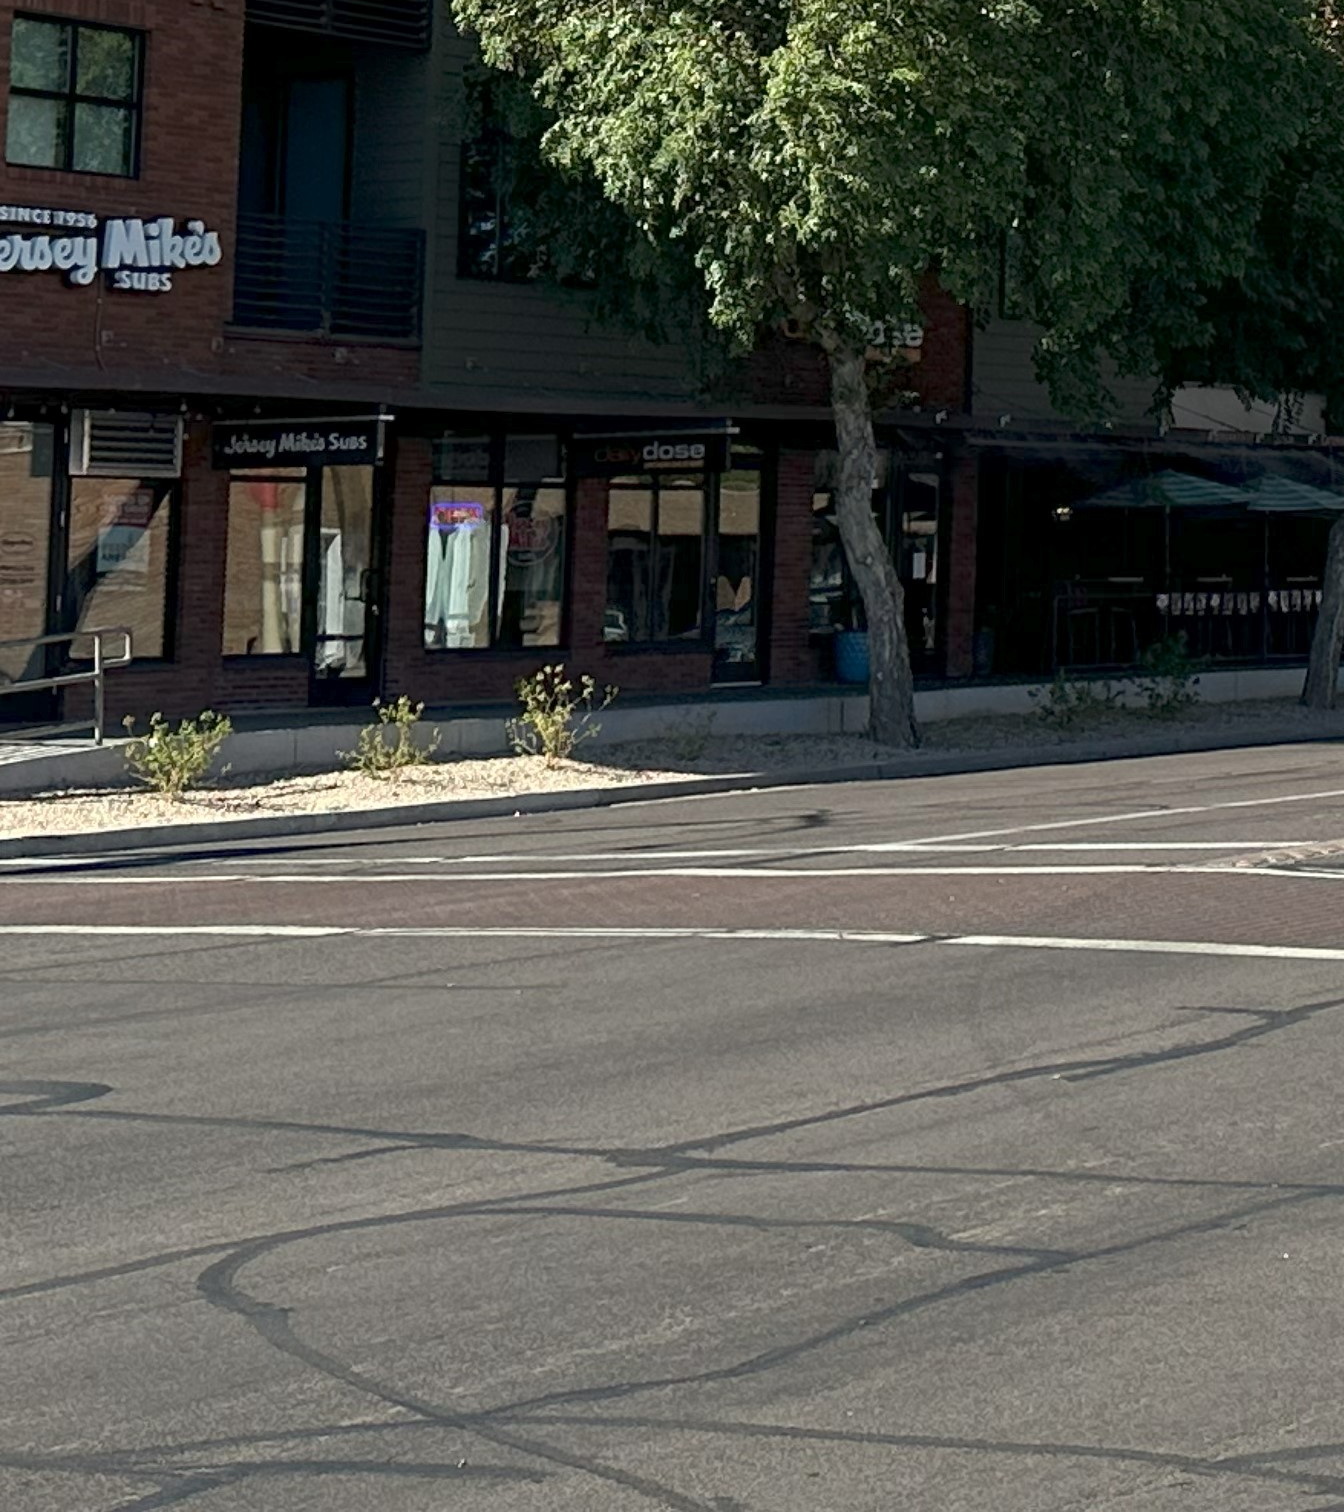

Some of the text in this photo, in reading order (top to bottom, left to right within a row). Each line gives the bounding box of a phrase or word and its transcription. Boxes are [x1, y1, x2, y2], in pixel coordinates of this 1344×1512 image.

[0, 205, 51, 225] SINCE
[0, 234, 98, 285] ersey
[113, 270, 172, 292] SUBS
[643, 440, 706, 461] dose
